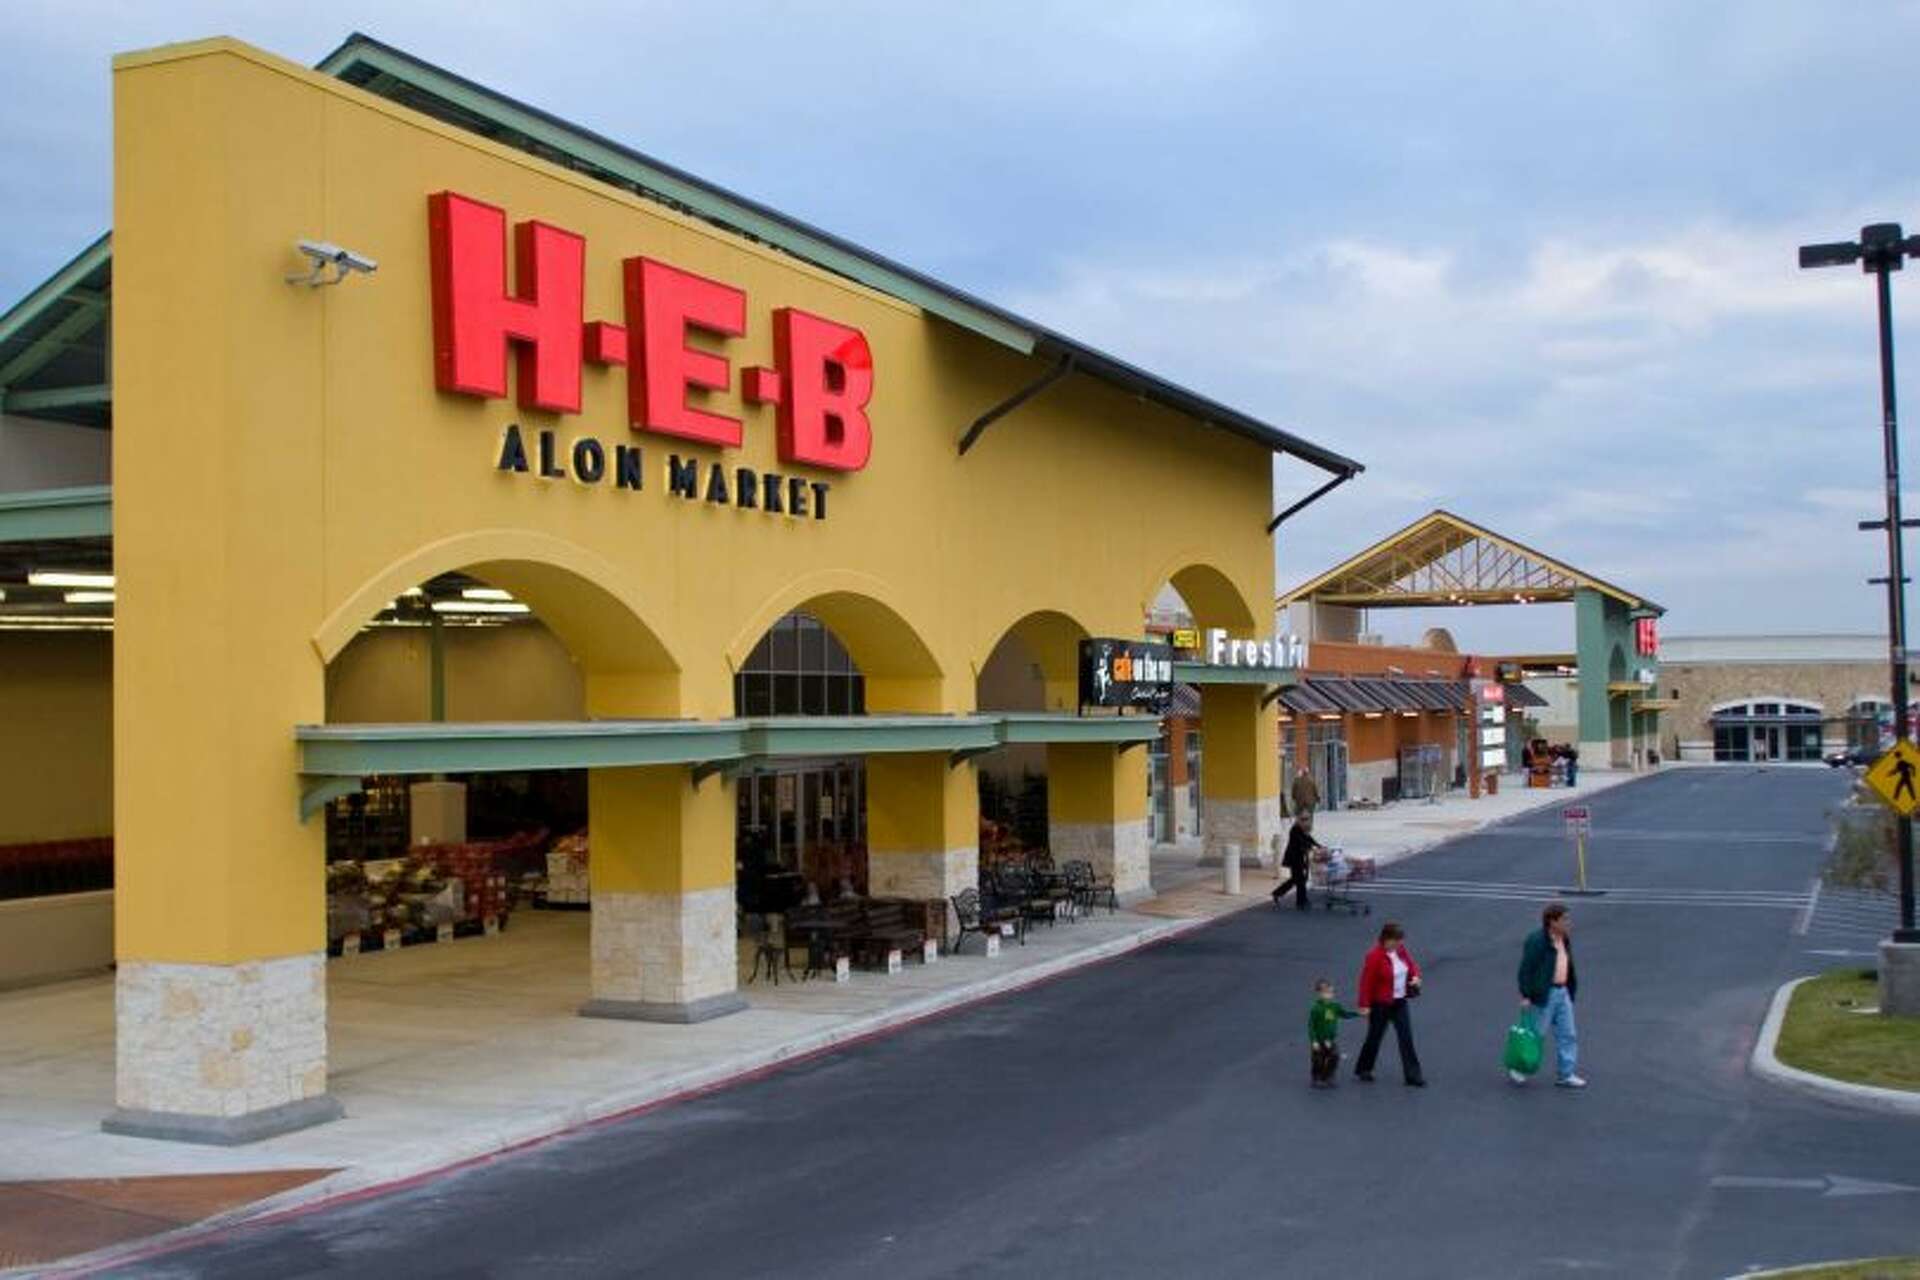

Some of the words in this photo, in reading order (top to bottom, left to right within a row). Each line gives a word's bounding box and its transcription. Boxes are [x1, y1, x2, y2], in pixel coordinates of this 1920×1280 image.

[427, 190, 873, 472] H-E-B
[498, 424, 643, 490] ALON
[668, 454, 830, 520] MARKET
